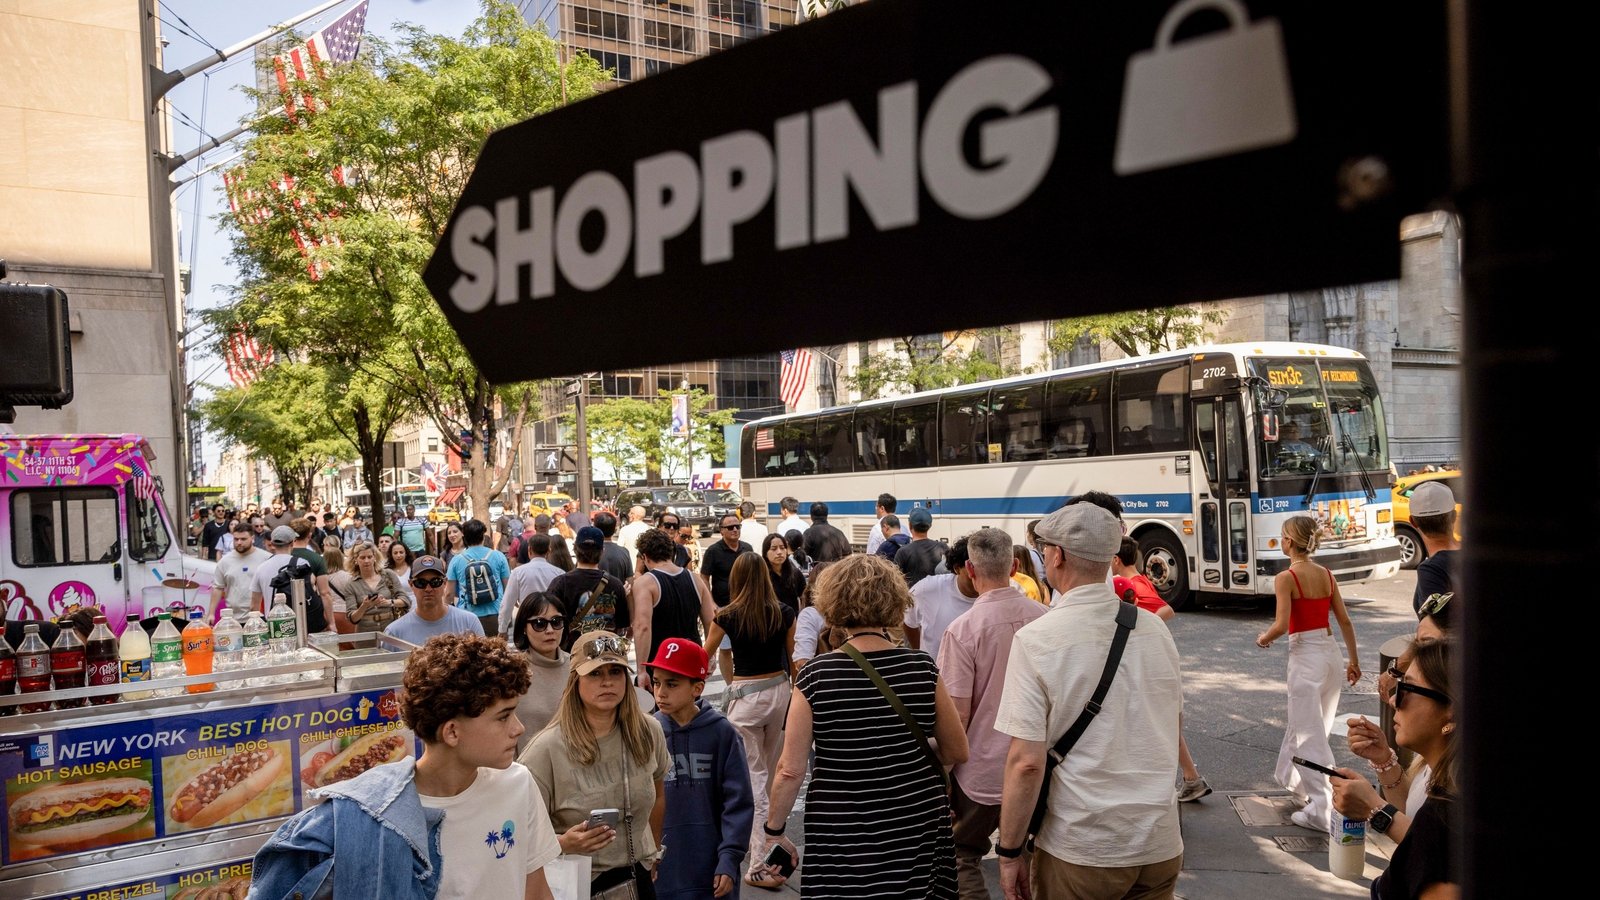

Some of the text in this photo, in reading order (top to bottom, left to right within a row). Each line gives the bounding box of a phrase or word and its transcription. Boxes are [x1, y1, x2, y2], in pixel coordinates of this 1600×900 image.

[449, 54, 1060, 312] SHOPPING
[1203, 366, 1226, 379] 2702
[1268, 365, 1304, 385] SIM3C
[1330, 370, 1358, 382] RICHMOND
[25, 455, 77, 466] 34-37 11TH ST
[45, 465, 56, 475] NY
[58, 465, 77, 475] 11106
[691, 473, 732, 490] FedEx
[1126, 500, 1137, 509] City
[1137, 500, 1149, 508] Bus
[1155, 500, 1169, 508] 2702
[1275, 500, 1290, 508] 2702
[666, 642, 680, 659] P
[59, 707, 353, 761] NEW YORK BEST HOT DOG
[300, 719, 404, 744] CHILI CHEESE DO
[186, 739, 269, 760] CHILI DOG
[17, 756, 142, 785] HOT SAUSAGE
[179, 862, 253, 888] HOT PRE
[86, 881, 162, 900] PRETZEL
